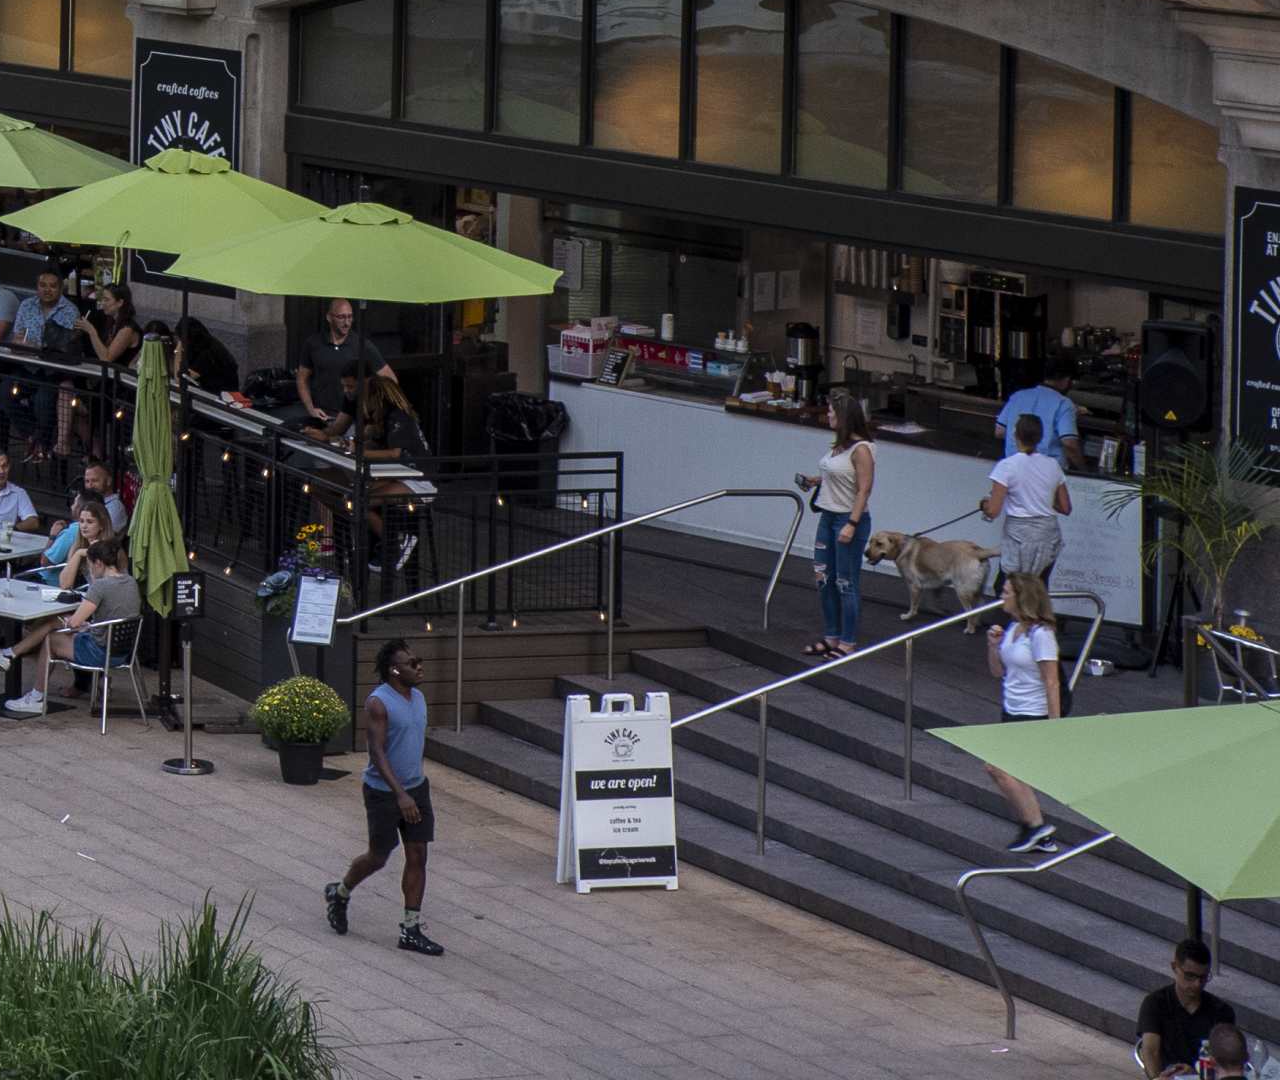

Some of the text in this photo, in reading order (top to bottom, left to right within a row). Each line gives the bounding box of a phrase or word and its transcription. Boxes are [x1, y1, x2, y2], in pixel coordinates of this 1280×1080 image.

[156, 83, 219, 99] crafted coffees
[148, 110, 182, 152] TINY
[604, 728, 640, 745] TINY CAFE
[590, 775, 657, 792] we are open!
